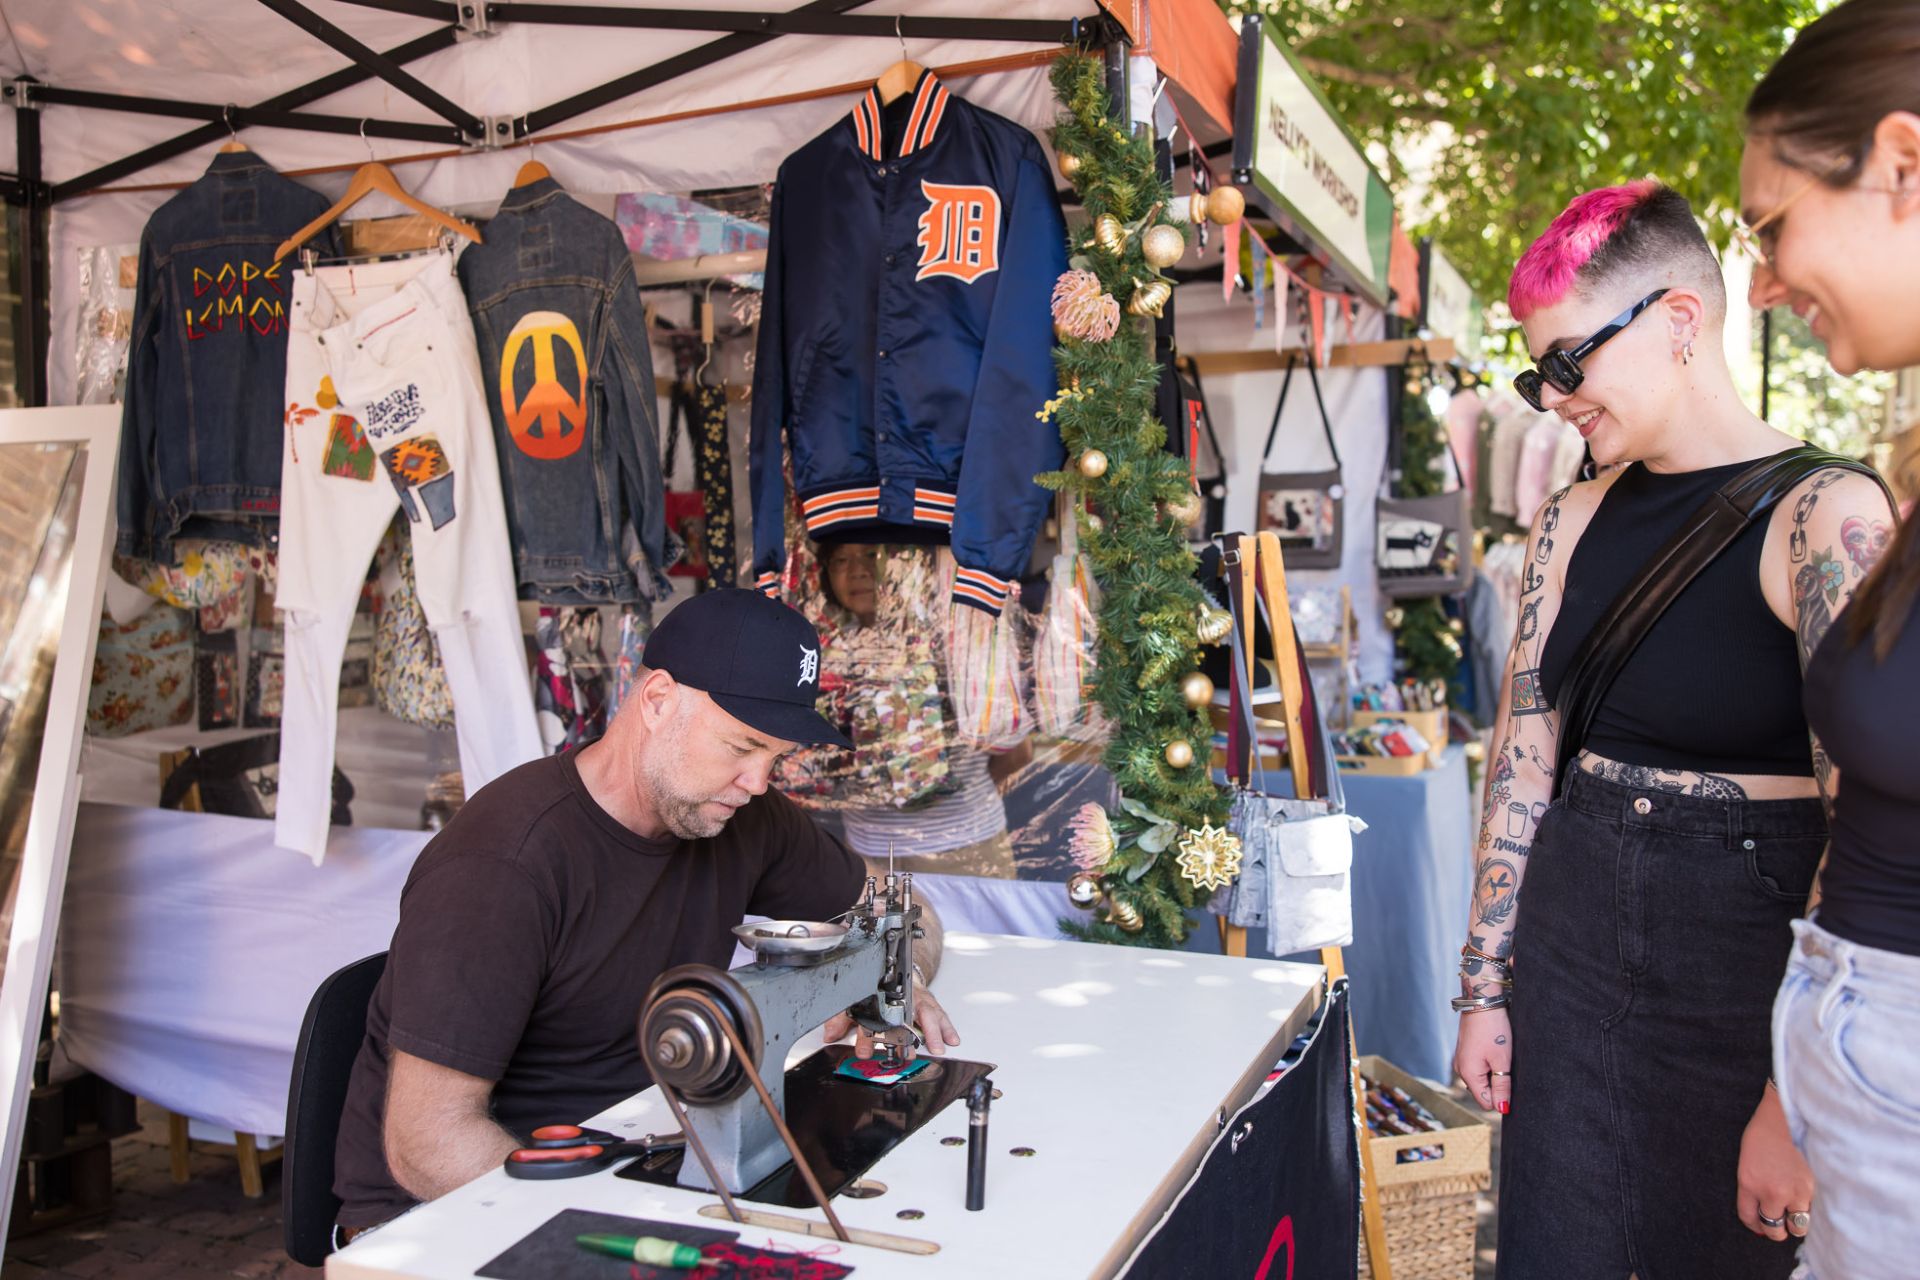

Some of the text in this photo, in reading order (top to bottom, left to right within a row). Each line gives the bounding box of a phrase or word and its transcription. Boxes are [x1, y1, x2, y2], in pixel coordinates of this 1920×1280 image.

[915, 178, 1001, 285] D
[193, 261, 285, 297] DOPE
[797, 643, 818, 687] D
